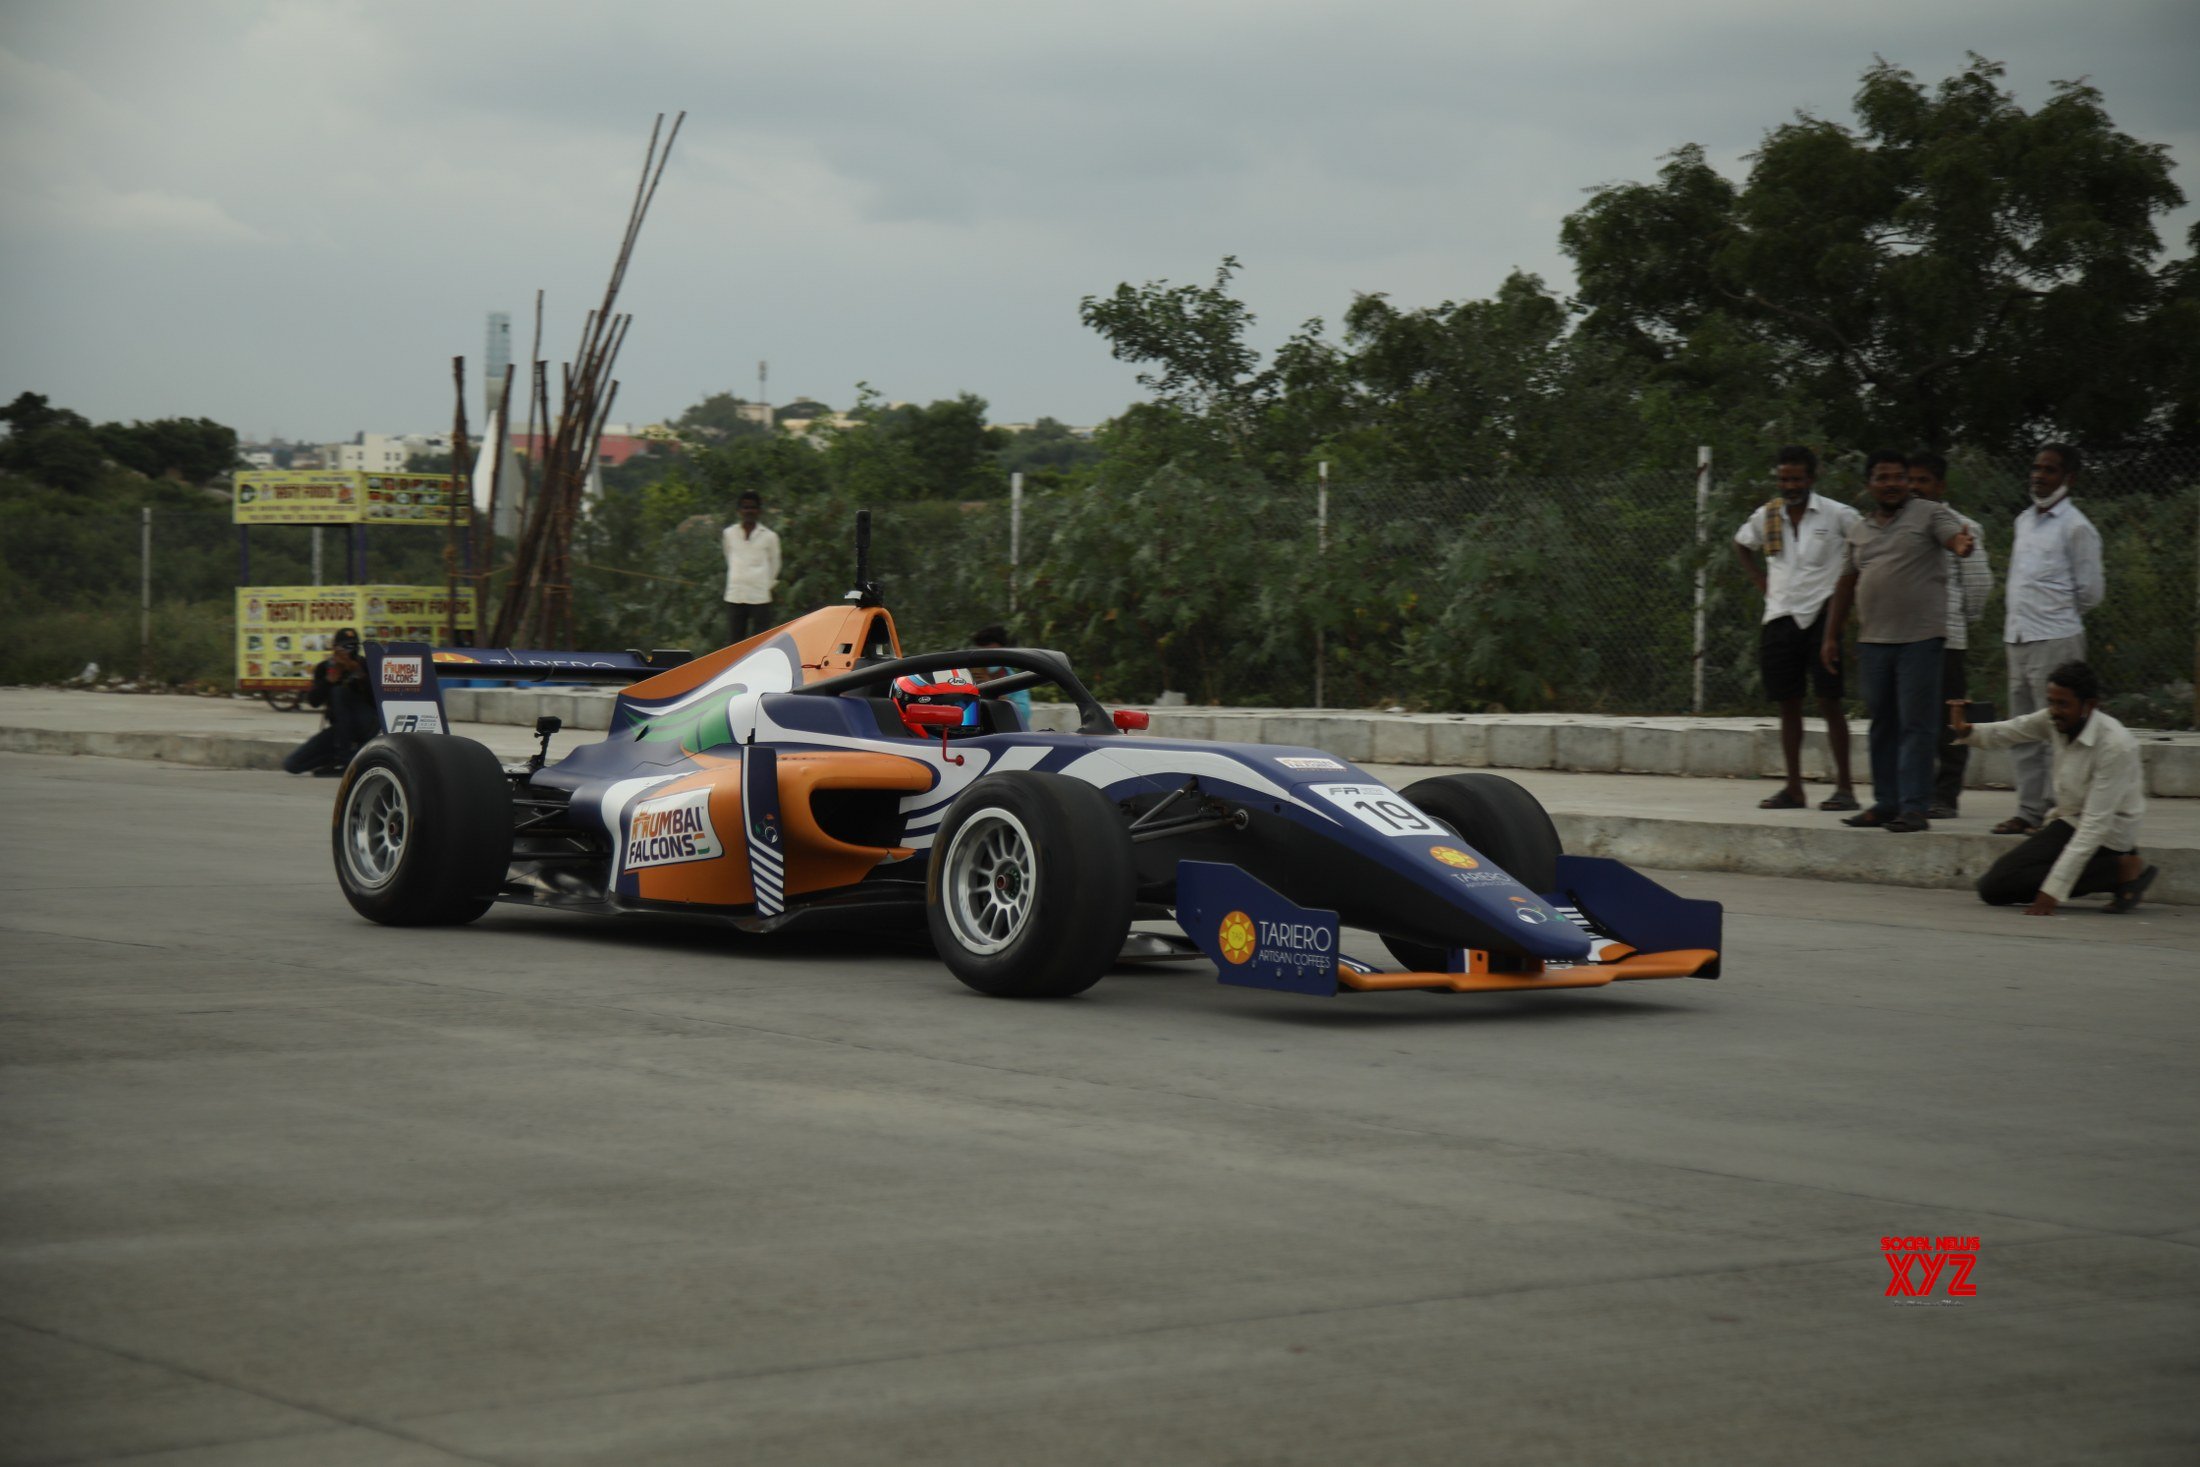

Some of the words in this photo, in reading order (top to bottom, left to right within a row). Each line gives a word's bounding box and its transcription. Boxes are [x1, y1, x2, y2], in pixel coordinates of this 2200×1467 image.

[265, 600, 305, 622] TASTY
[310, 600, 354, 622] FOODS
[386, 599, 424, 614] TASTY
[384, 661, 418, 674] MUMBAI
[384, 674, 413, 683] FALCONS
[391, 715, 419, 733] FR
[1329, 787, 1360, 795] FR
[632, 806, 703, 841] MUMBAI
[1353, 801, 1431, 830] 19
[629, 834, 696, 864] FALCONS
[1259, 921, 1332, 951] TARIERO
[1258, 949, 1292, 964] ARTISAN
[1293, 953, 1331, 969] COFFEES
